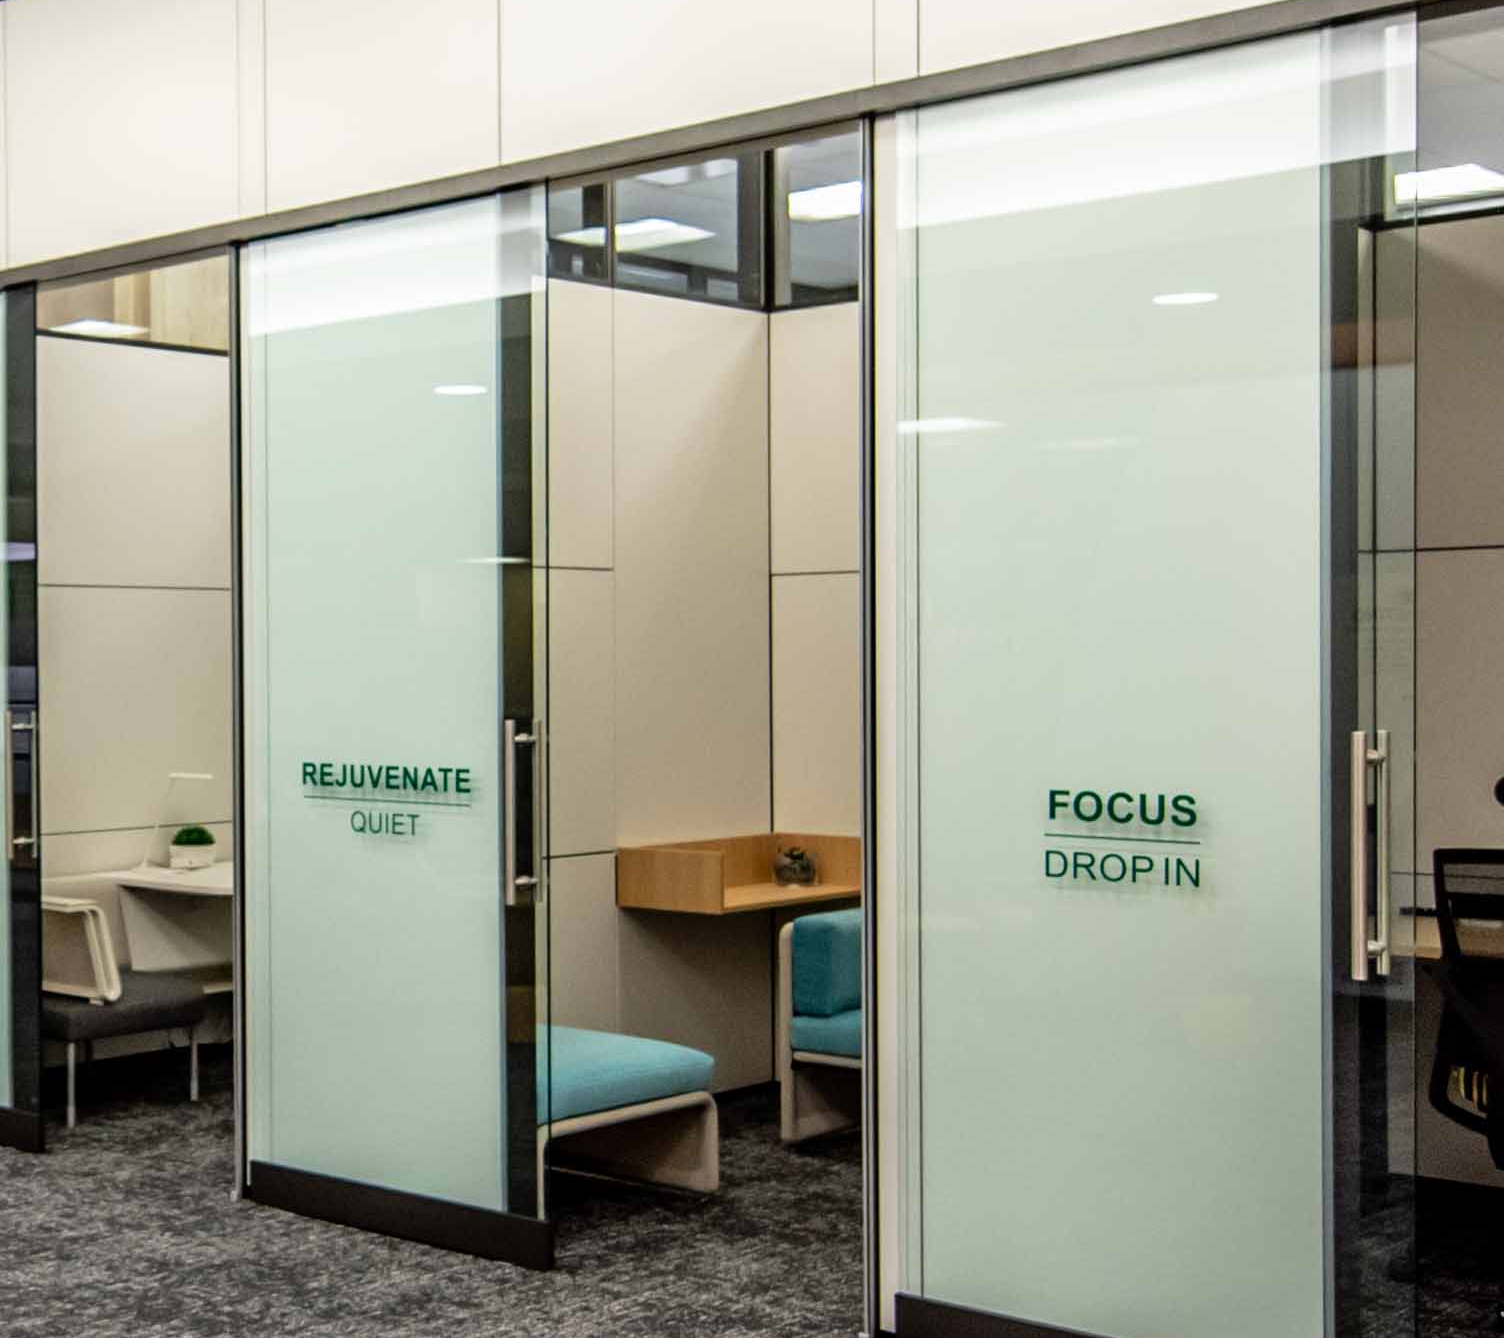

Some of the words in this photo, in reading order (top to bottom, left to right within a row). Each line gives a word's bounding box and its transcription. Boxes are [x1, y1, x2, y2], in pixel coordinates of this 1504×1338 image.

[301, 762, 473, 795] REJUVENATE
[349, 809, 420, 838] QUIET
[1048, 789, 1198, 828] FOCUS
[1044, 849, 1155, 884] DROP
[1163, 856, 1201, 888] IN
